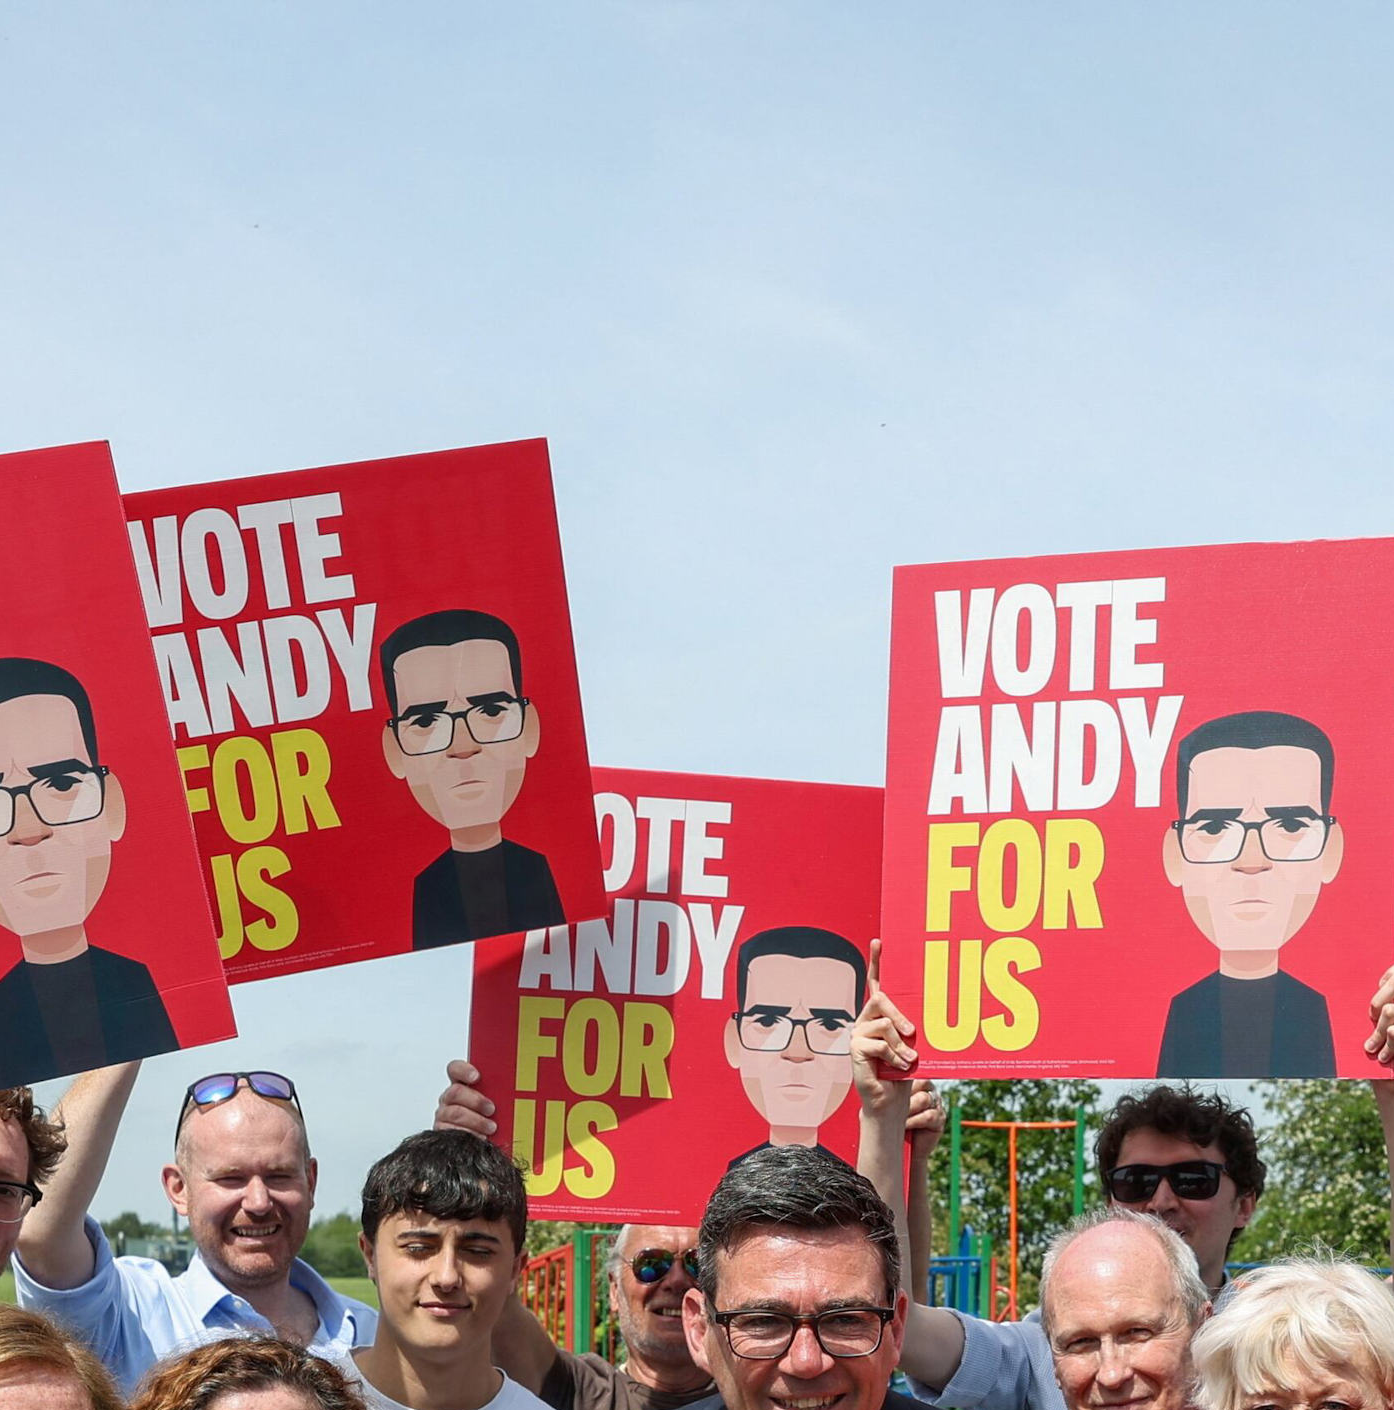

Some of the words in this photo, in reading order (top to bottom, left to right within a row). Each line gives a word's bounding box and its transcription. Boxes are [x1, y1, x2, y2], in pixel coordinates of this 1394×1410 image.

[126, 492, 355, 628] VOTE
[152, 603, 378, 740] ANDY
[934, 576, 1167, 698] VOTE
[926, 695, 1184, 816] ANDY
[925, 818, 1105, 932] FOR
[516, 899, 745, 1001] ANDY
[922, 937, 1042, 1052] US
[514, 996, 675, 1101] FOR
[512, 1100, 618, 1199] US
